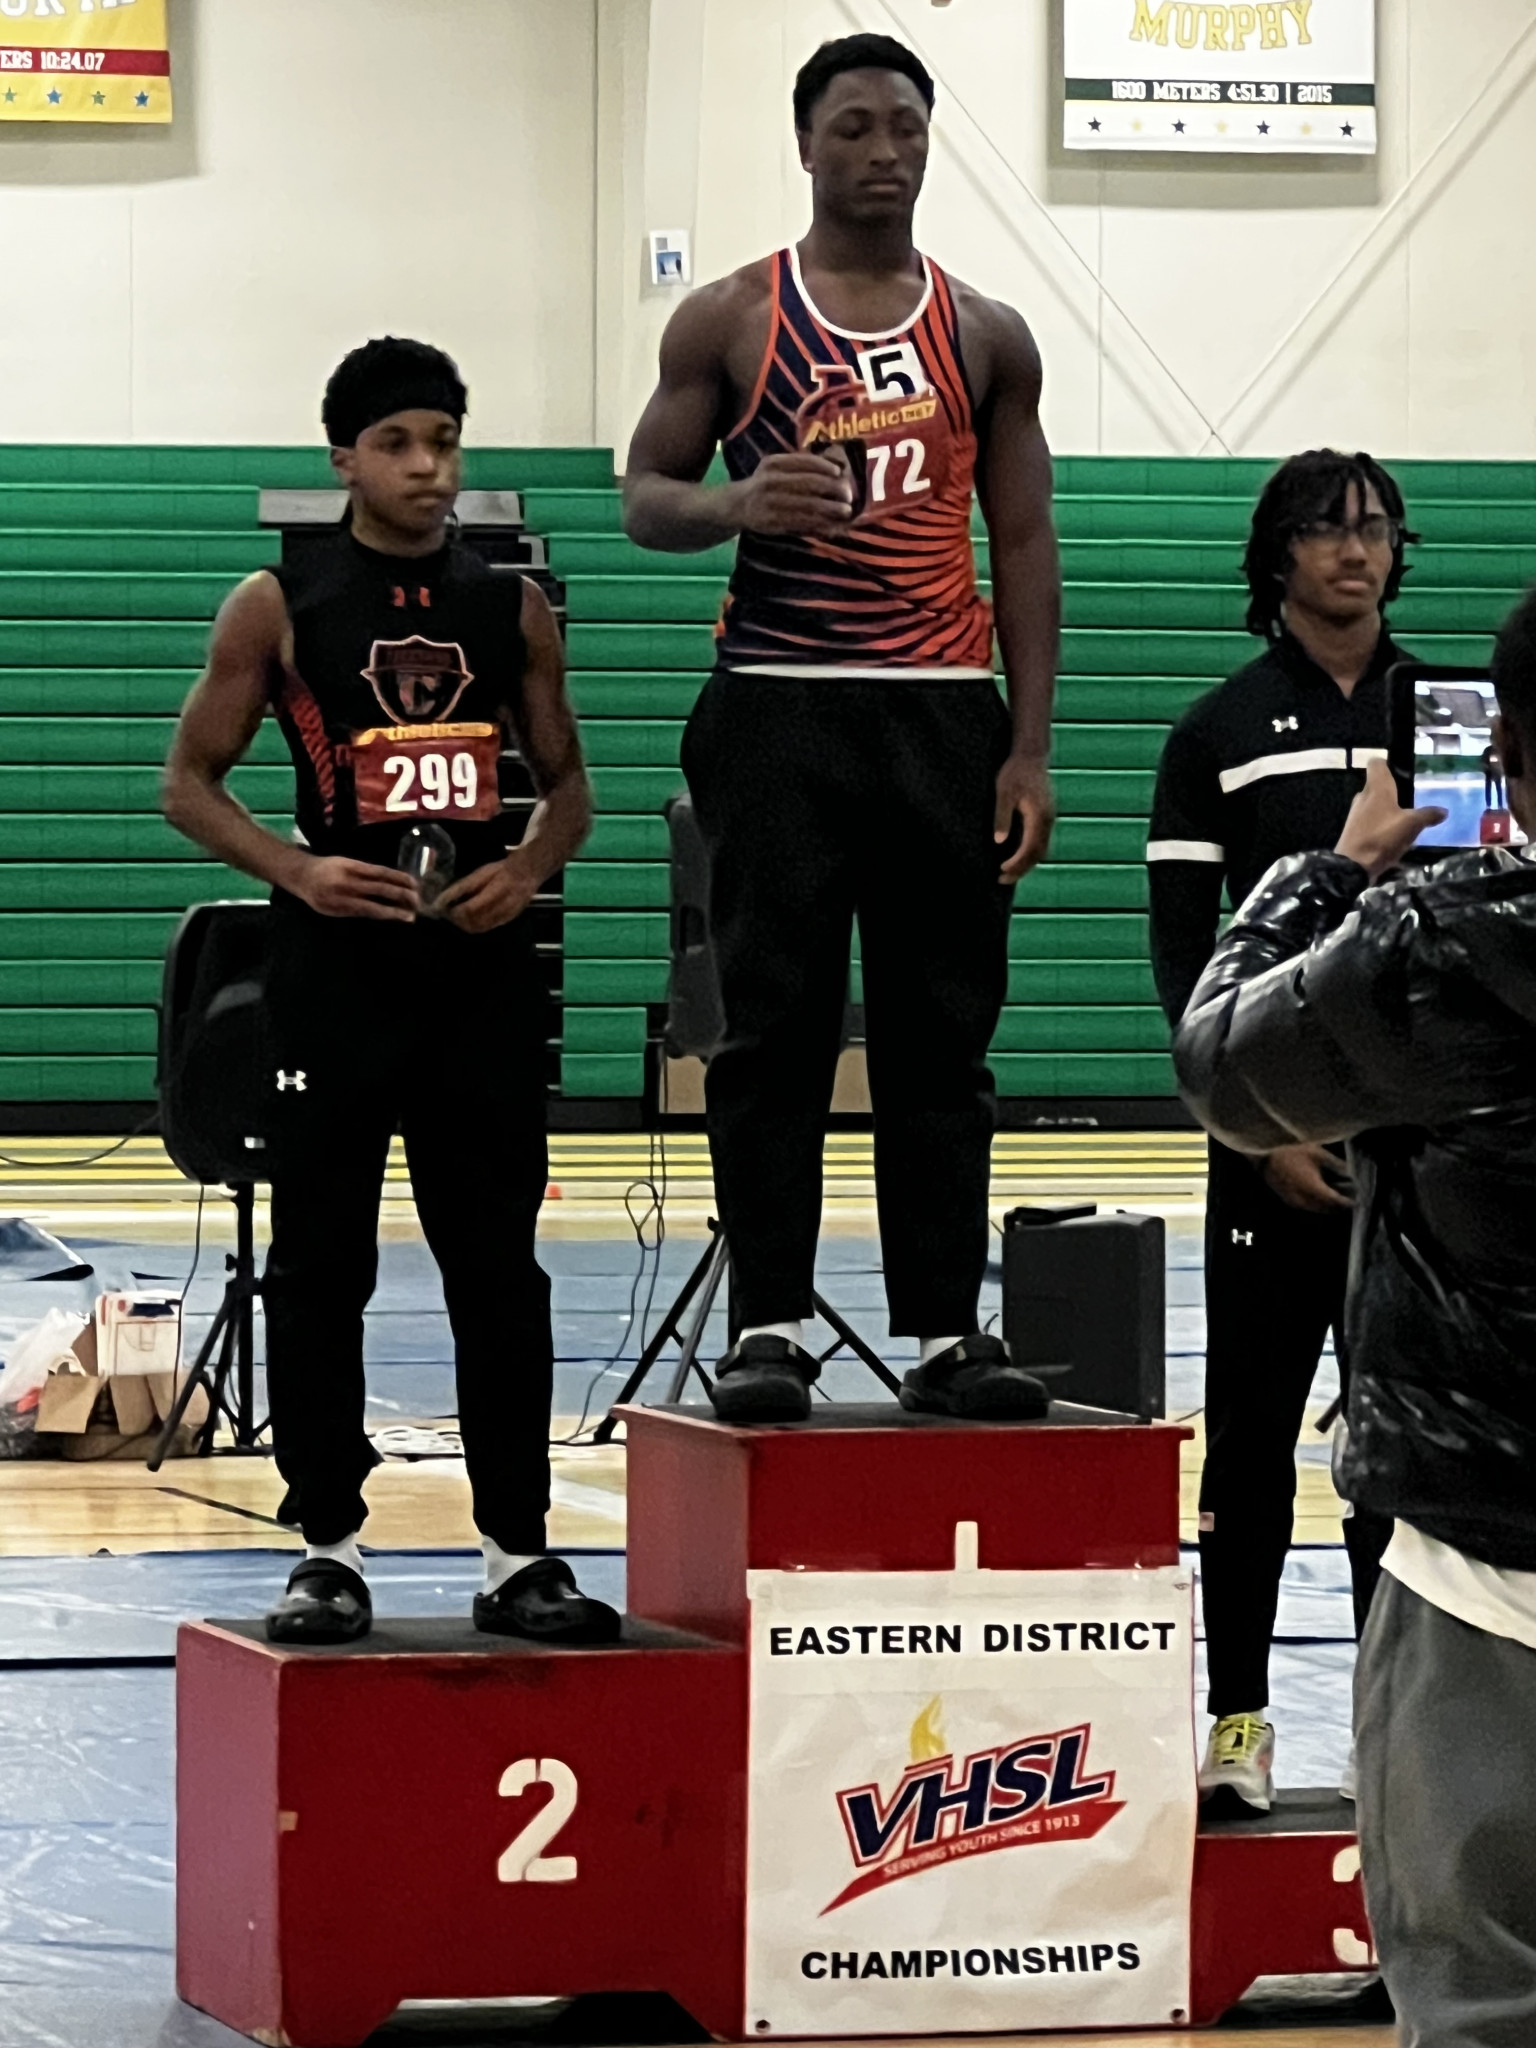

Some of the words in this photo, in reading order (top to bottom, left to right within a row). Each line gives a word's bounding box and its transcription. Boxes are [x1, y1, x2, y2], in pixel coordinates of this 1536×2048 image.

[1129, 0, 1312, 51] MURPHY
[40, 51, 106, 71] 10:24.07
[1111, 81, 1147, 100] 1600
[1152, 82, 1221, 102] METERS
[1297, 85, 1333, 103] 2015
[869, 350, 917, 398] 5
[383, 752, 478, 812] 299
[769, 1624, 962, 1656] EASTERN
[983, 1621, 1176, 1653] DISTRICT
[498, 1758, 578, 1883] 2
[843, 1730, 1110, 1862] VHSL
[883, 1845, 948, 1878] SERVING
[948, 1832, 998, 1857] YOUTH
[999, 1820, 1041, 1842] SINCE
[1044, 1814, 1081, 1831] 1913
[800, 1942, 1141, 1980] CHAMPIONSHIPS
